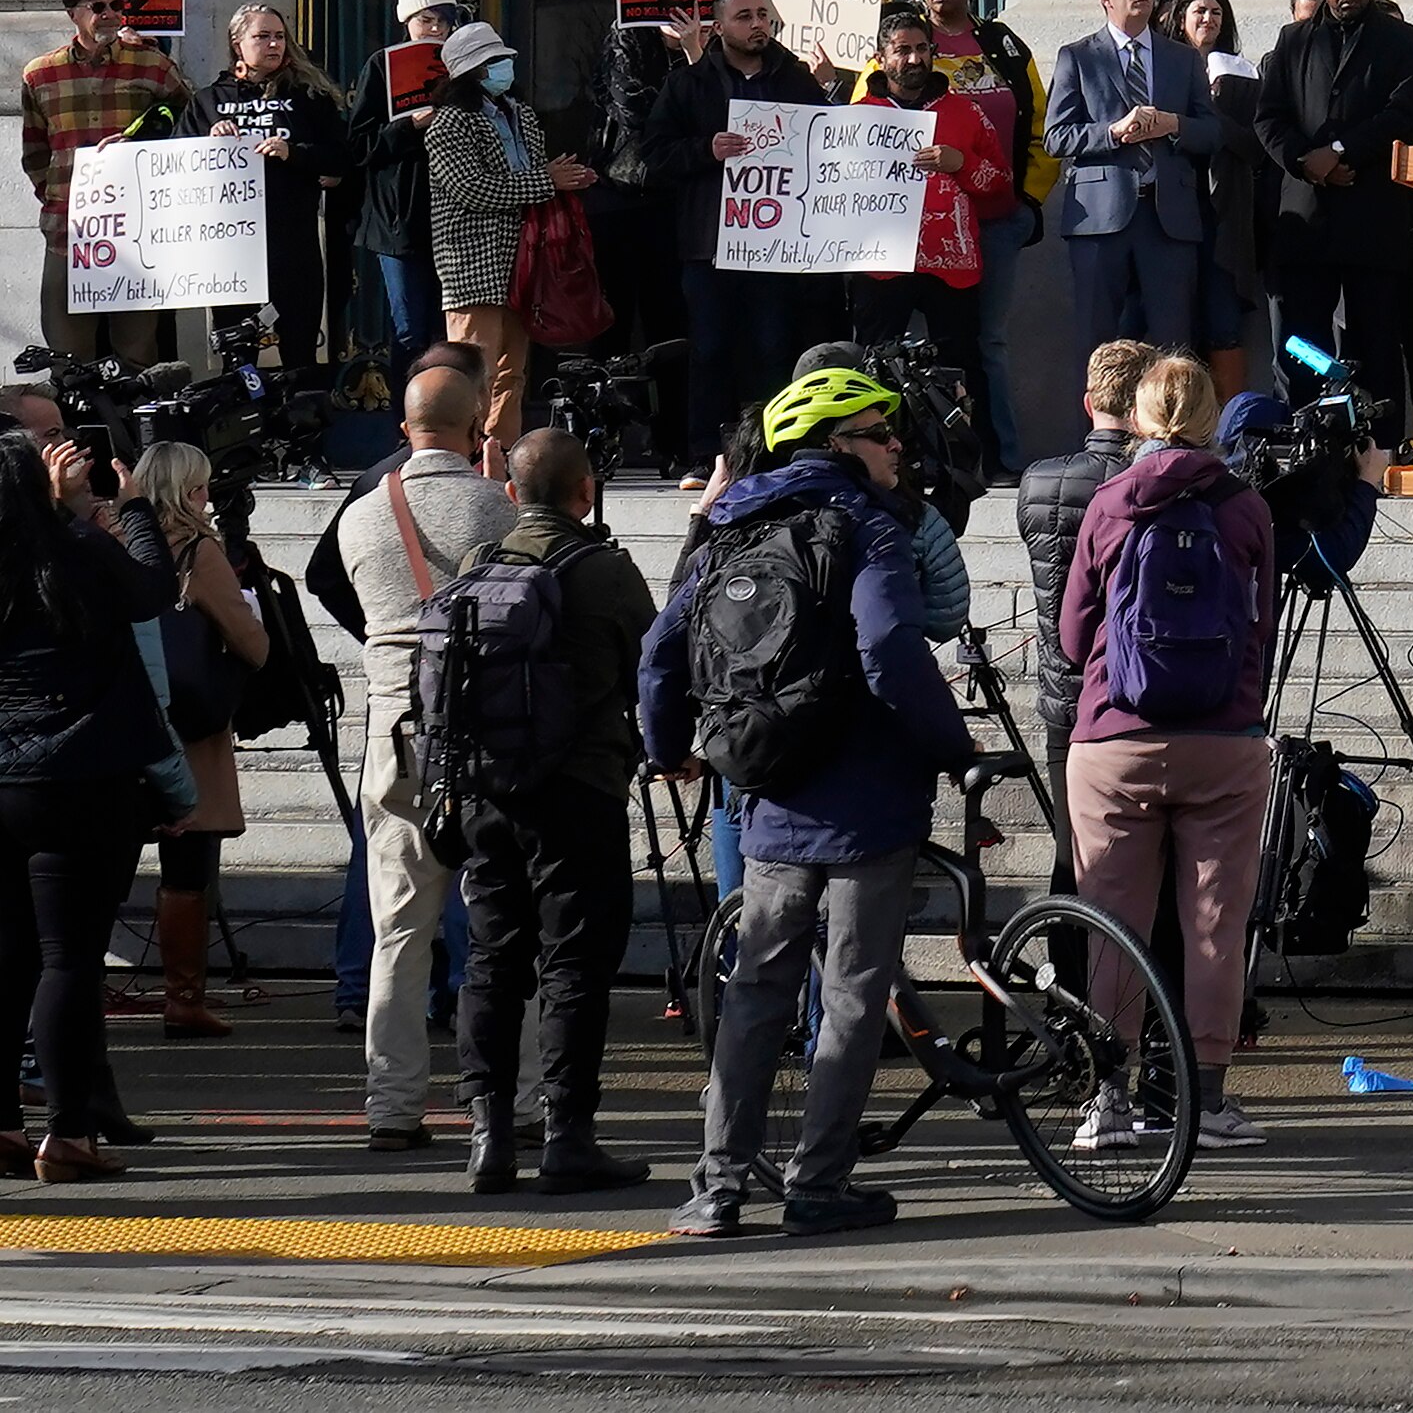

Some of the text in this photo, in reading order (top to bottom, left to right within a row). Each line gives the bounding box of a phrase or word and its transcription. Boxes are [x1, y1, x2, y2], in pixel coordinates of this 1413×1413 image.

[836, 32, 876, 62] COPS
[217, 99, 294, 114] UNFUCK
[235, 113, 273, 127] THE
[238, 127, 290, 139] ORLD
[823, 123, 925, 152] BLANK CHECKS
[78, 160, 105, 186] SF
[150, 146, 249, 178] BLANK CHECKS
[816, 162, 841, 183] 375
[844, 160, 885, 181] SECRET
[726, 166, 793, 196] VOTE
[149, 189, 172, 210] 375
[177, 185, 216, 206] SECRET
[812, 192, 909, 217] KILLER ROBOTS
[72, 213, 126, 239] VOTE
[724, 197, 783, 229] NO
[150, 220, 257, 245] KILLER ROBOTS
[72, 239, 117, 269] NO
